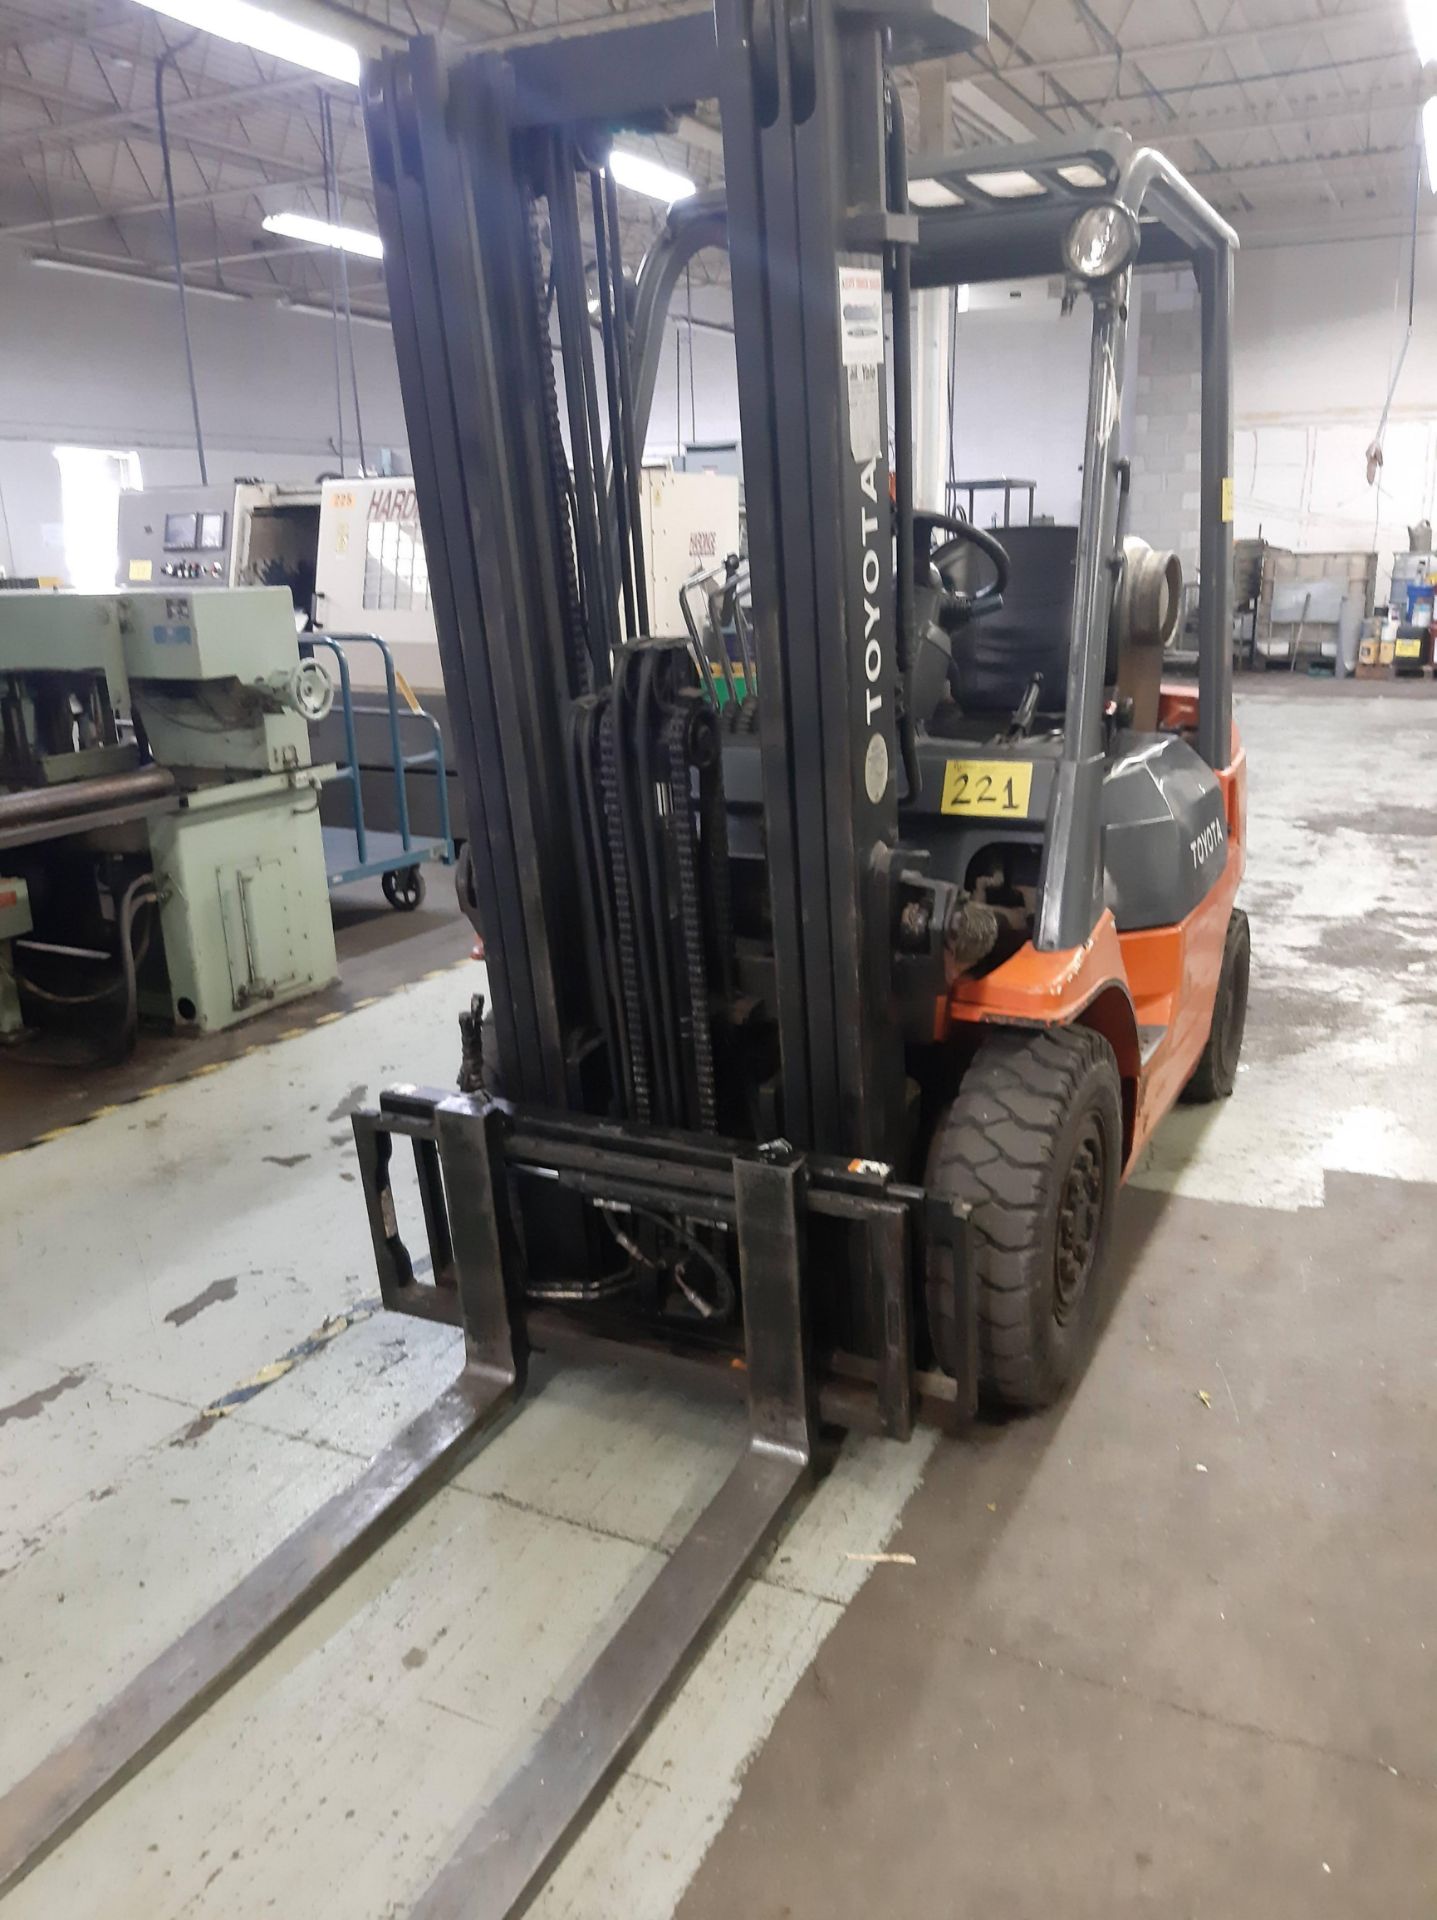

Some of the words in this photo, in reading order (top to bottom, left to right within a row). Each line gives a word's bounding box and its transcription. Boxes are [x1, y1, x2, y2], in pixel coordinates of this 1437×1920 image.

[861, 457, 882, 726] TOYOTA
[950, 773, 1019, 810] 221
[1190, 816, 1224, 870] TOYOTA
